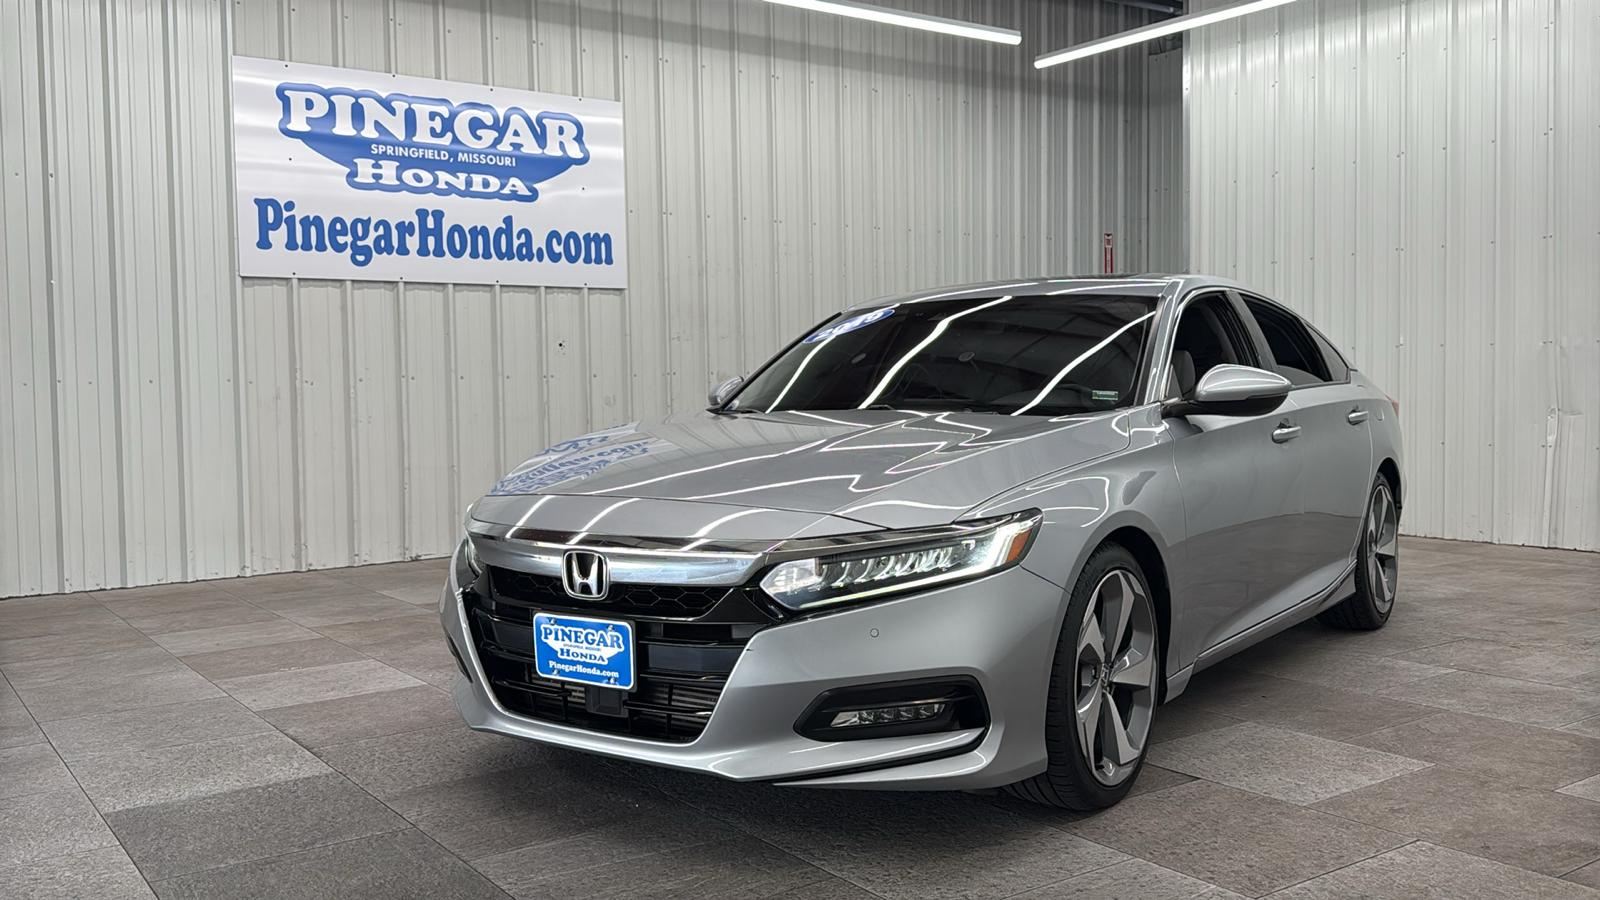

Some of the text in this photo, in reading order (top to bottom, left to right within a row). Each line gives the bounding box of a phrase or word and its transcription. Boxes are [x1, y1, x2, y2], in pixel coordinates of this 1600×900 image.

[283, 89, 585, 159] PINEGAR
[370, 143, 517, 168] SPRINGFIELD, MISSOURI
[353, 158, 533, 196] HONDA
[254, 197, 614, 267] PinegarHonda.com
[543, 627, 622, 649] PINEGAR
[559, 648, 606, 662] HONDA
[548, 660, 619, 678] PinegarHonda.com
